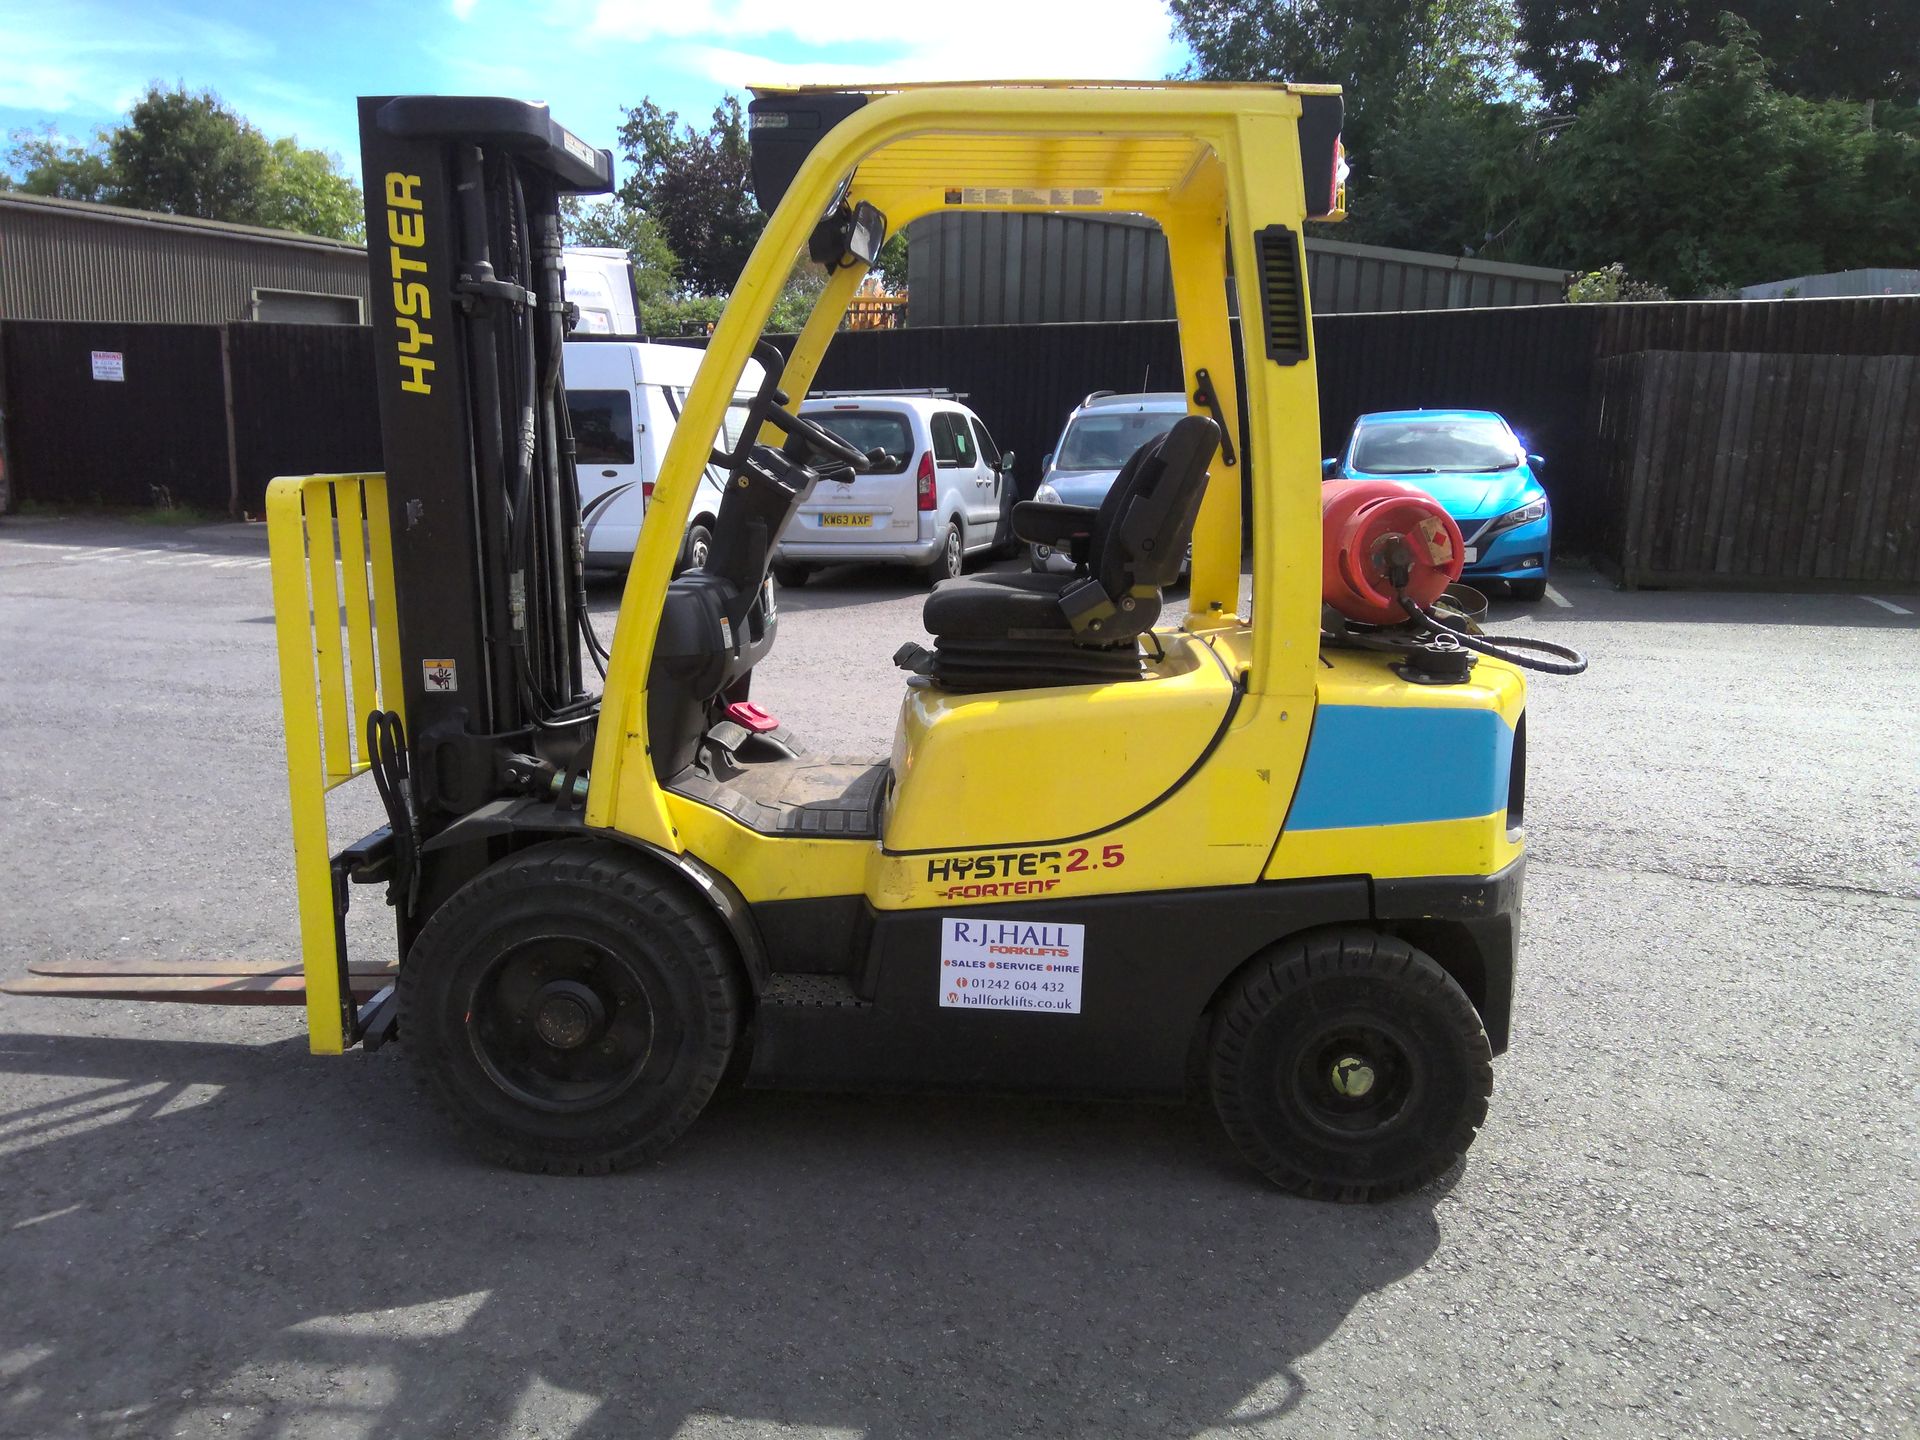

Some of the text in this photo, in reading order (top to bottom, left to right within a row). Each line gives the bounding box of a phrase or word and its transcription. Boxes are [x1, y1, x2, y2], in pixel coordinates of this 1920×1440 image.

[385, 171, 435, 394] HYSTER
[824, 515, 870, 525] KW63 AXF
[1065, 844, 1125, 873] 2.5
[954, 922, 1069, 947] R.J.HALL
[989, 945, 1069, 957] FORKLIFTS
[951, 959, 1080, 973] SALES SERVICE HIRE
[971, 978, 1065, 993] 01242 604 432
[963, 993, 1072, 1009] hallforklifts.co.uk
